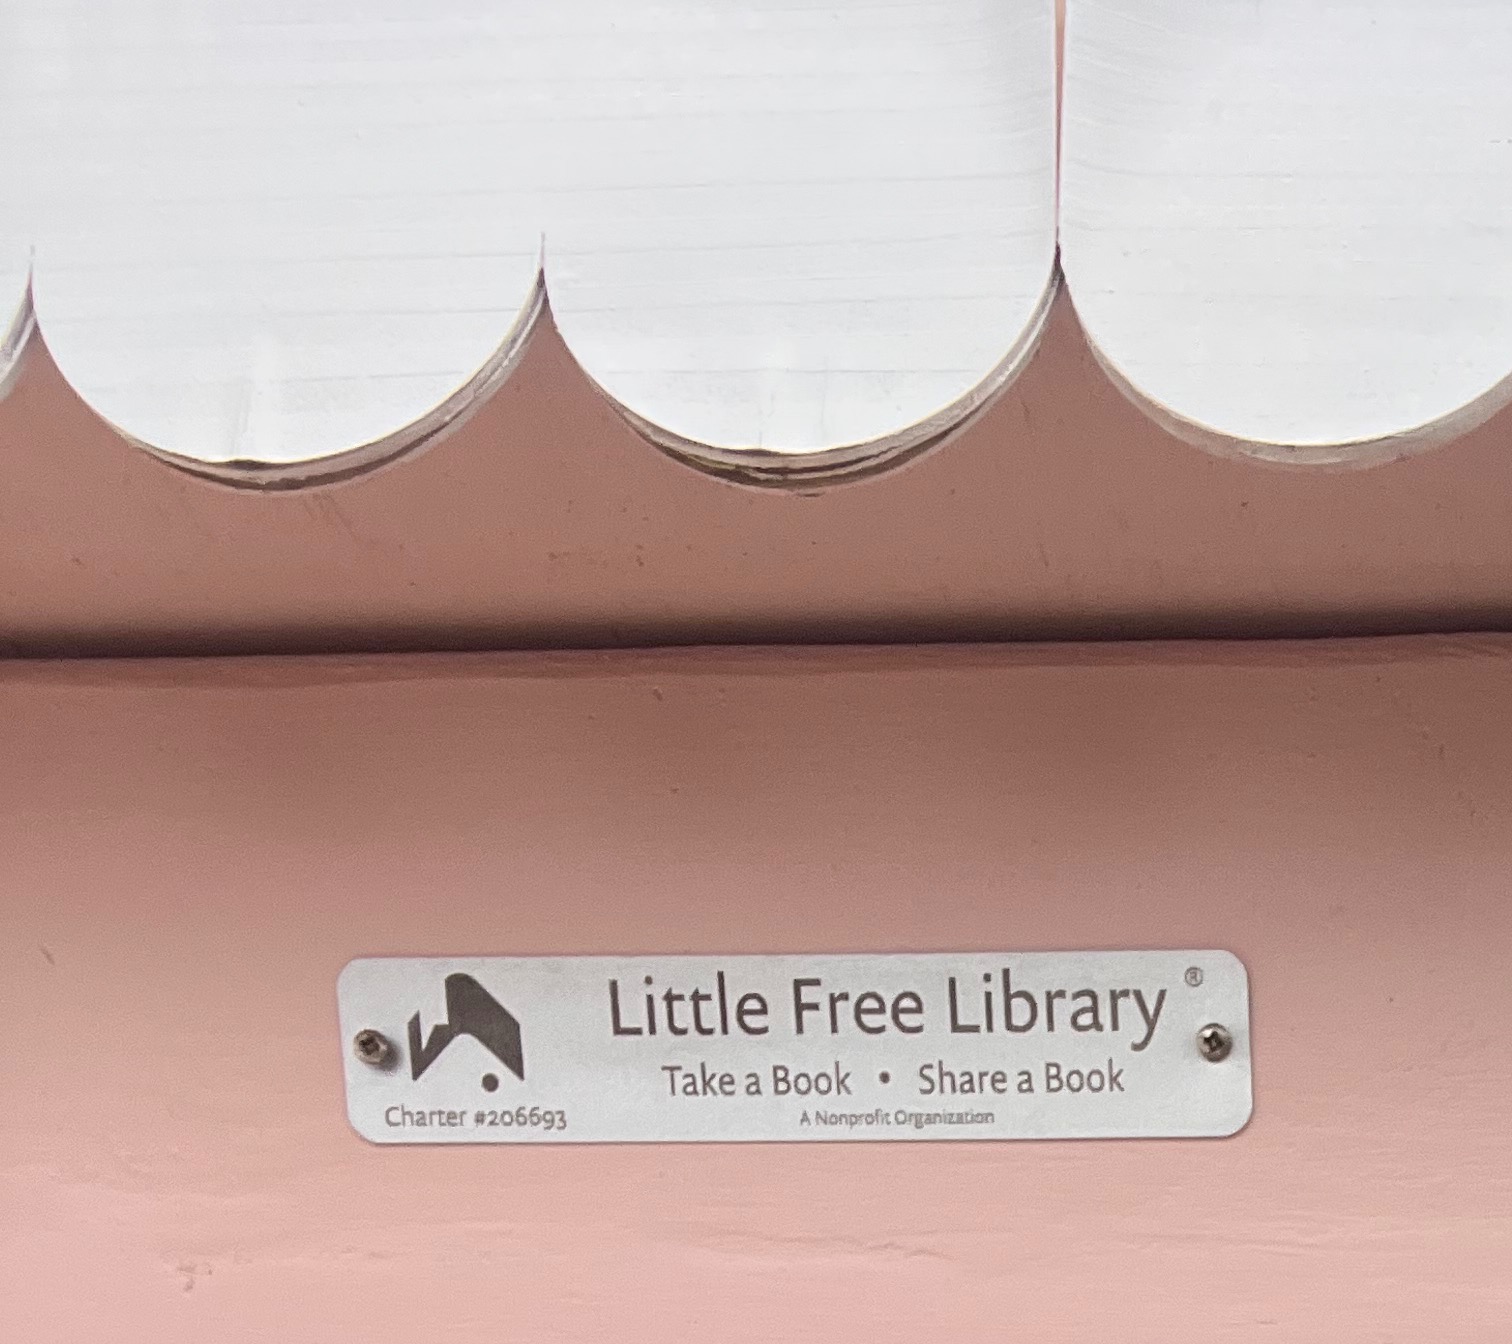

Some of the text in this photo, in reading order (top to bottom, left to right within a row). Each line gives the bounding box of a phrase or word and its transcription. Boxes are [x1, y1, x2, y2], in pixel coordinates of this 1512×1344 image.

[608, 968, 1168, 1052] Little Free Library
[661, 1058, 1125, 1097] Take a Book Share a Book
[385, 1105, 568, 1131] Charter #206693
[800, 1108, 996, 1130] A Nonprofit Organization
